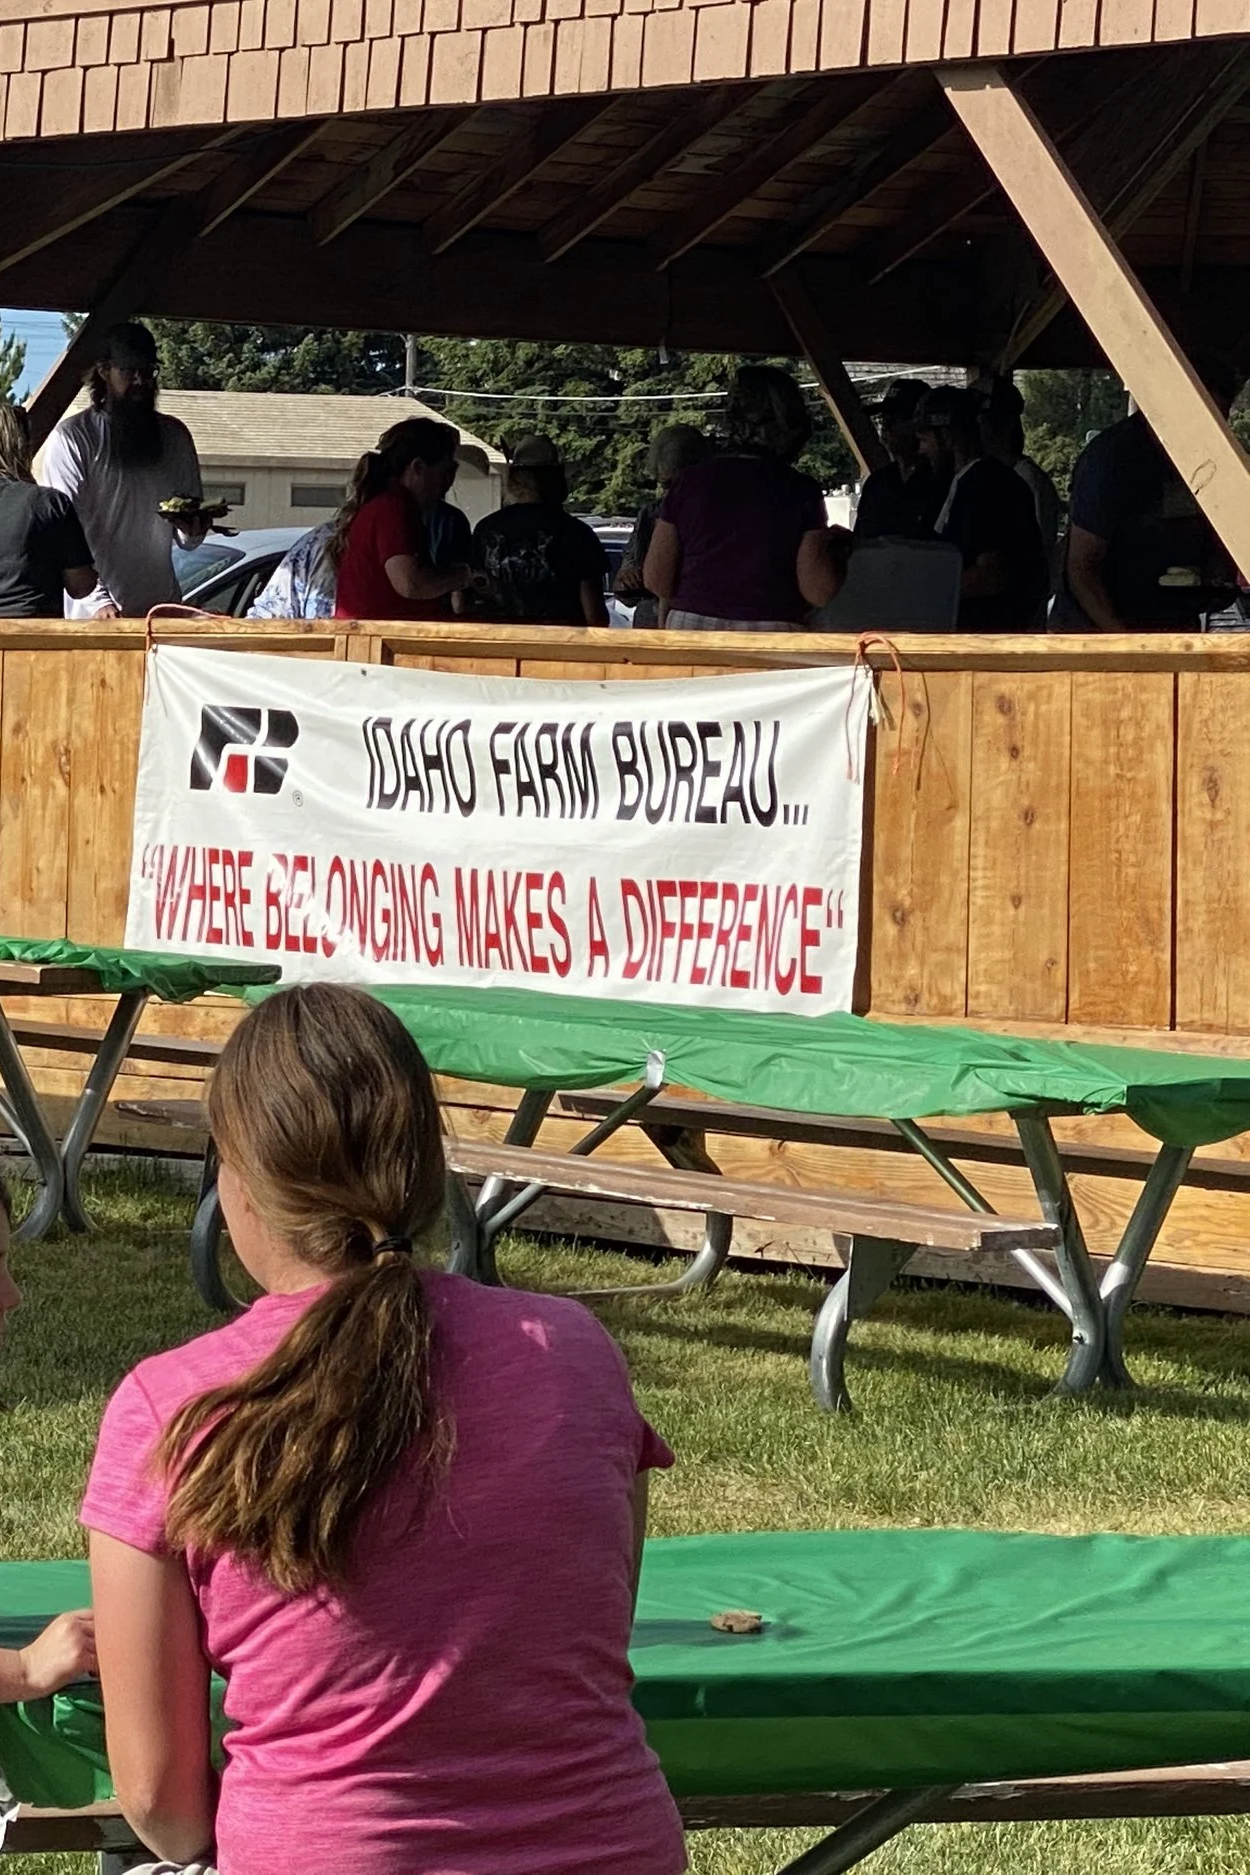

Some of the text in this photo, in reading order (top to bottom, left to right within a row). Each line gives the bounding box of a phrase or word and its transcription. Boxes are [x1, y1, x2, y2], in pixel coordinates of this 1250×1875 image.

[362, 717, 810, 828] IDAHO FARM BUREAU...
[264, 852, 445, 968] BELONGING
[453, 866, 572, 977] MAKES
[588, 877, 611, 976] A
